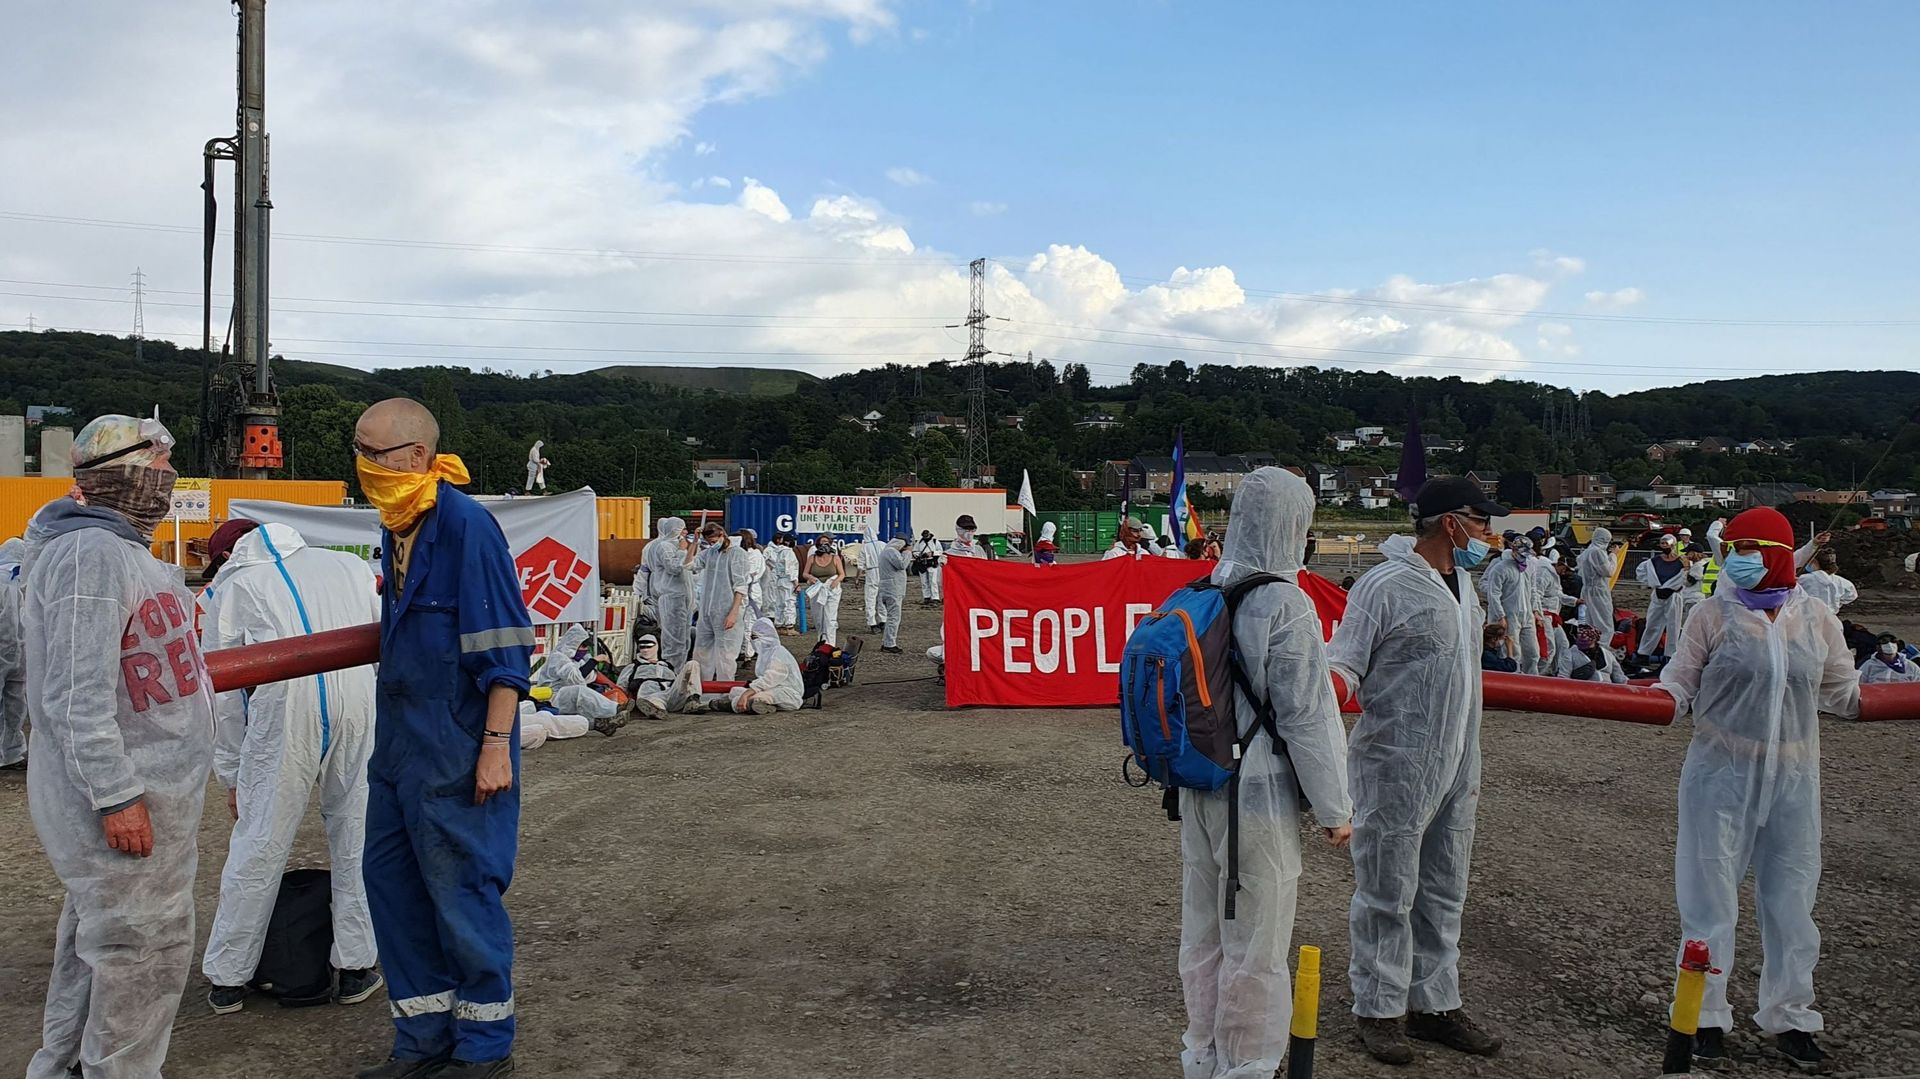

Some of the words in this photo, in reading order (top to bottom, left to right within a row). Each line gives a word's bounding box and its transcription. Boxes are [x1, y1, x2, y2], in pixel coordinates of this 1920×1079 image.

[808, 496, 826, 504] DES
[830, 496, 878, 506] FACTURES
[800, 505, 848, 514] PAYABLES
[854, 506, 872, 514] SUR
[800, 514, 818, 522] UNE
[824, 514, 867, 523] PLANETE
[815, 523, 856, 532] VIVABLE
